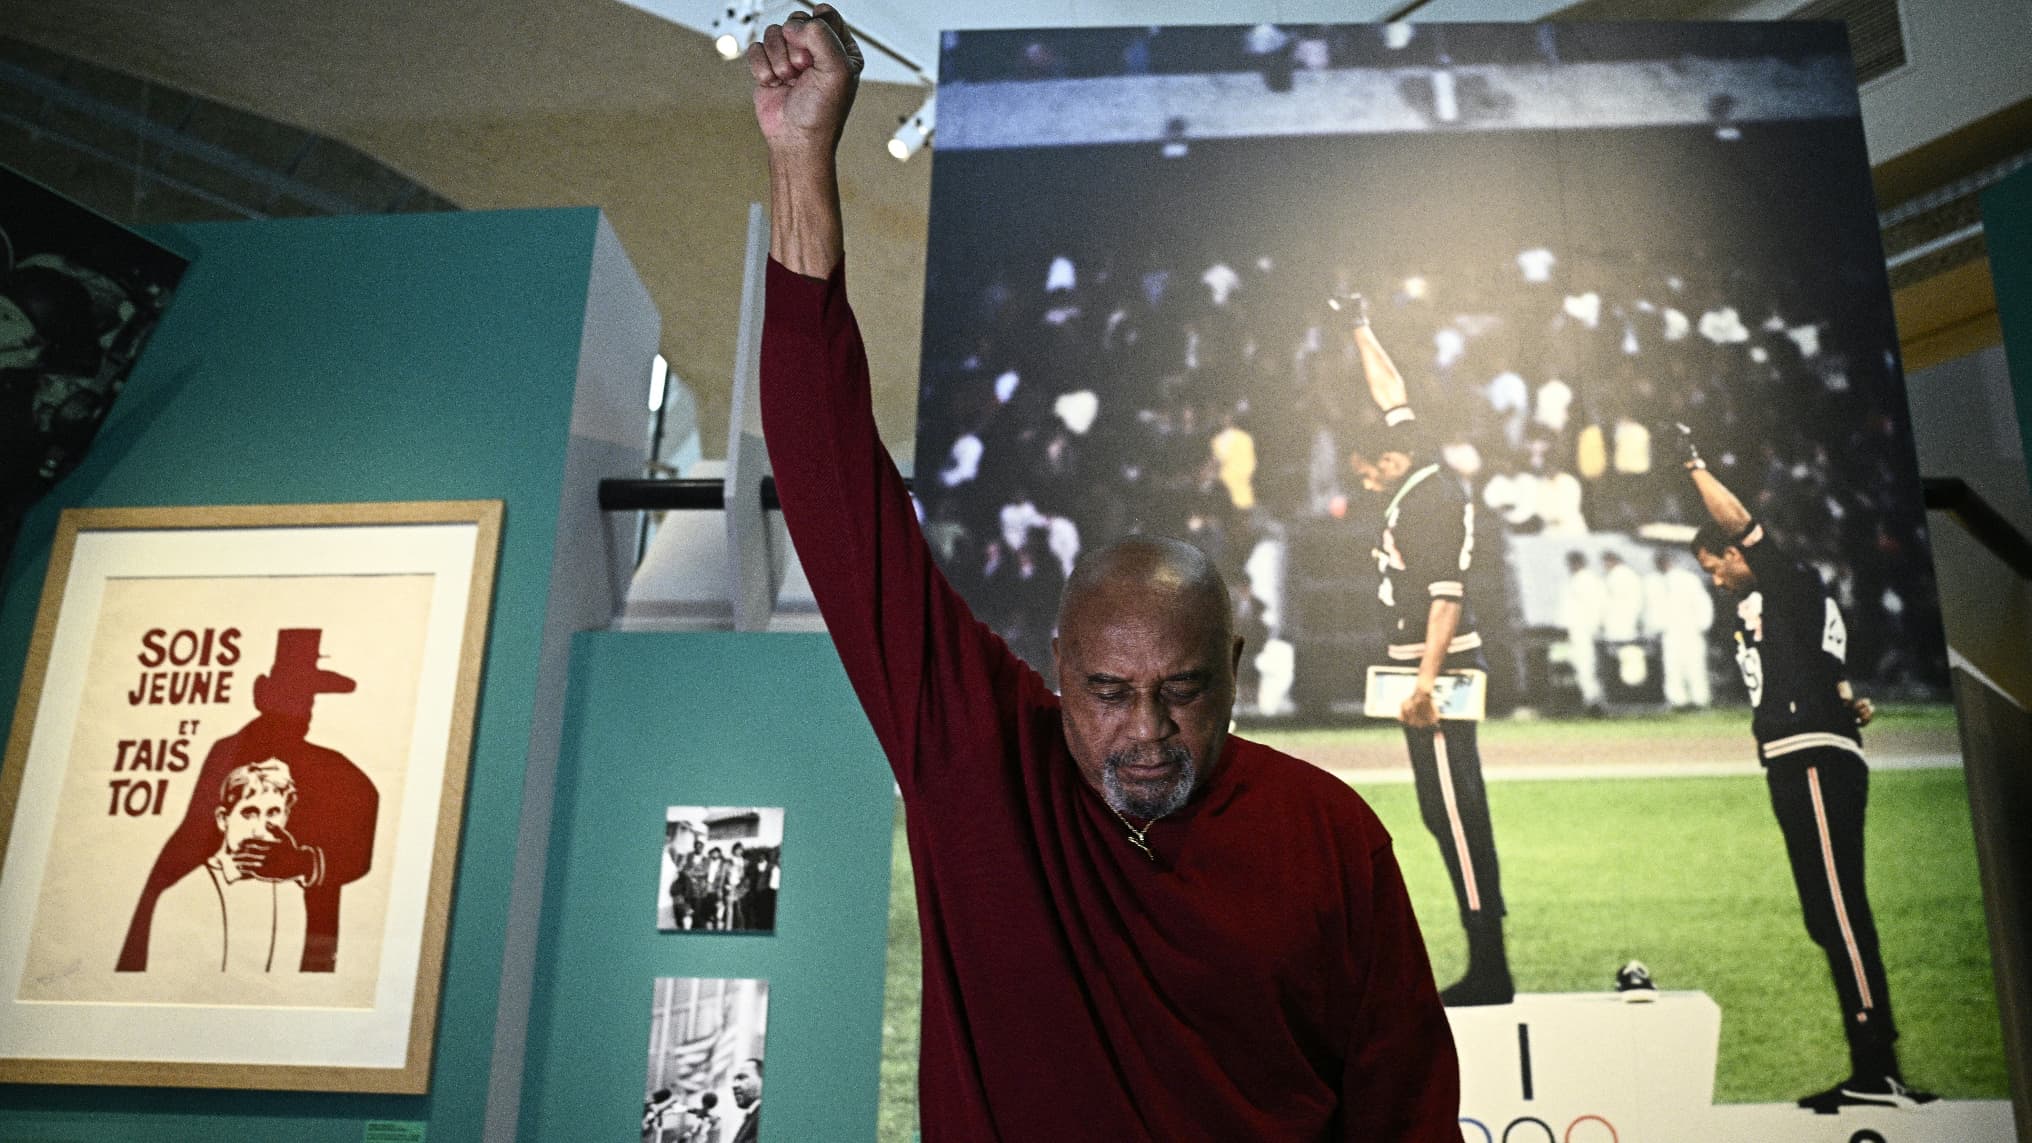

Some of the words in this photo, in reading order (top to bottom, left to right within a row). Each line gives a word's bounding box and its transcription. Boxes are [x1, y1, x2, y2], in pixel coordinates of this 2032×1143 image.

[138, 627, 242, 667] SOIS
[129, 671, 233, 705] JEUNE
[178, 720, 200, 735] ET
[113, 739, 190, 772] TAIS
[108, 779, 169, 816] TOI
